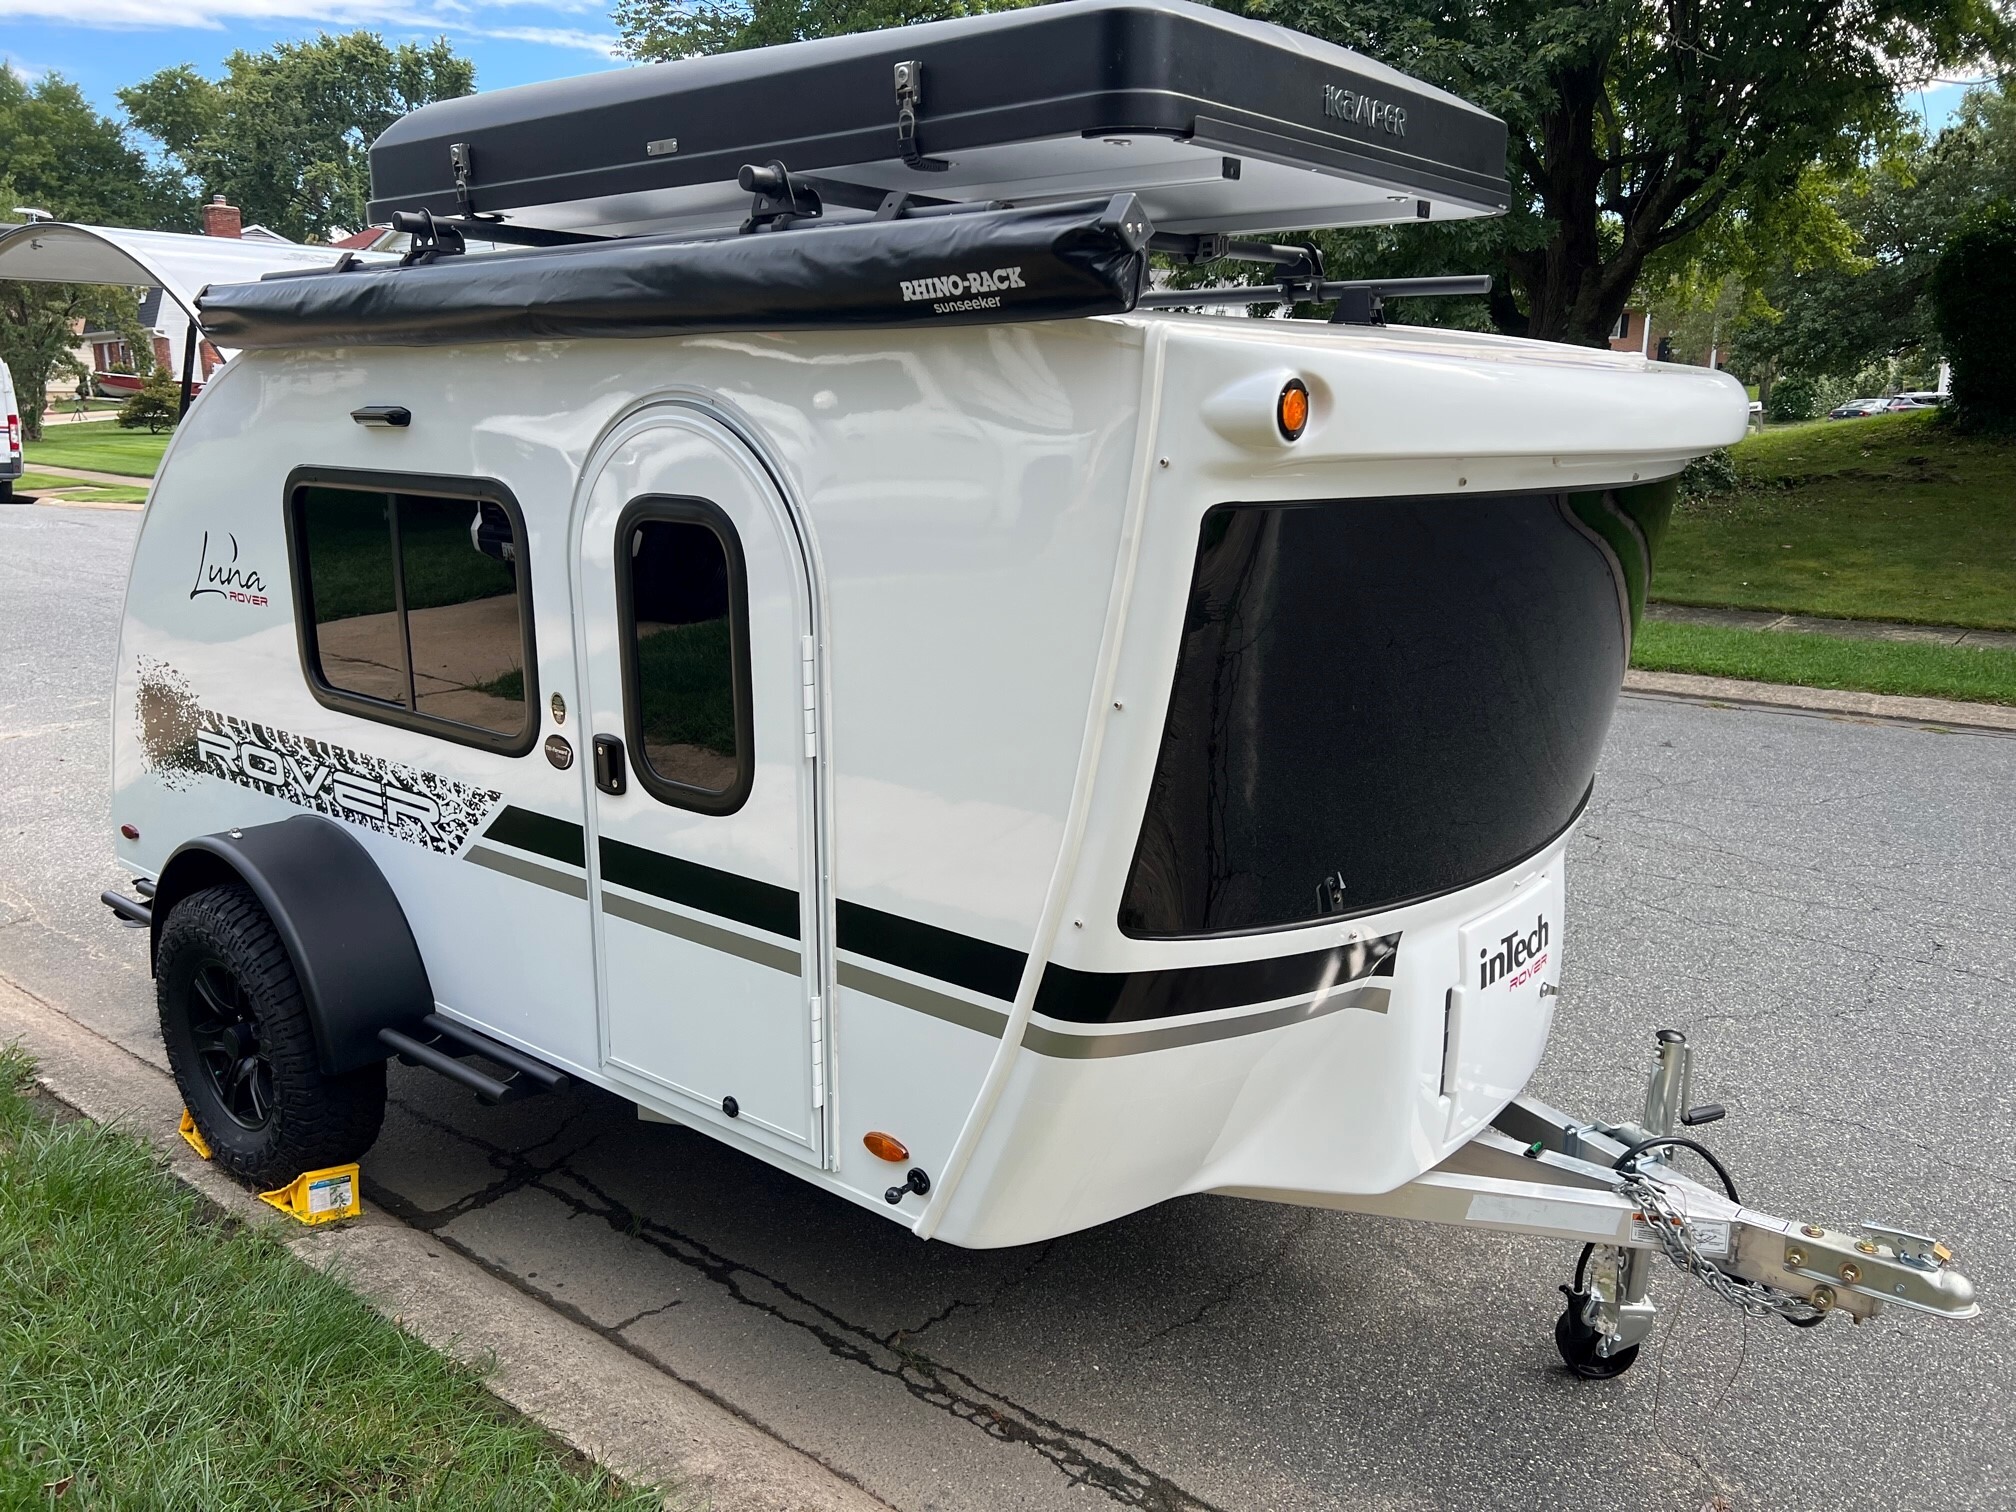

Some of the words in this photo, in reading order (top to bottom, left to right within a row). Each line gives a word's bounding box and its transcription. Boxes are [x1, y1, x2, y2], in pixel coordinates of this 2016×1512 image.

[900, 267, 1026, 301] RHINO-RACK
[933, 297, 1001, 313] sunseeker
[190, 531, 267, 600] Luna
[229, 591, 268, 607] ROVER
[197, 730, 441, 838] ROVER
[1480, 913, 1549, 990] inTech
[1509, 953, 1547, 992] ROVER
